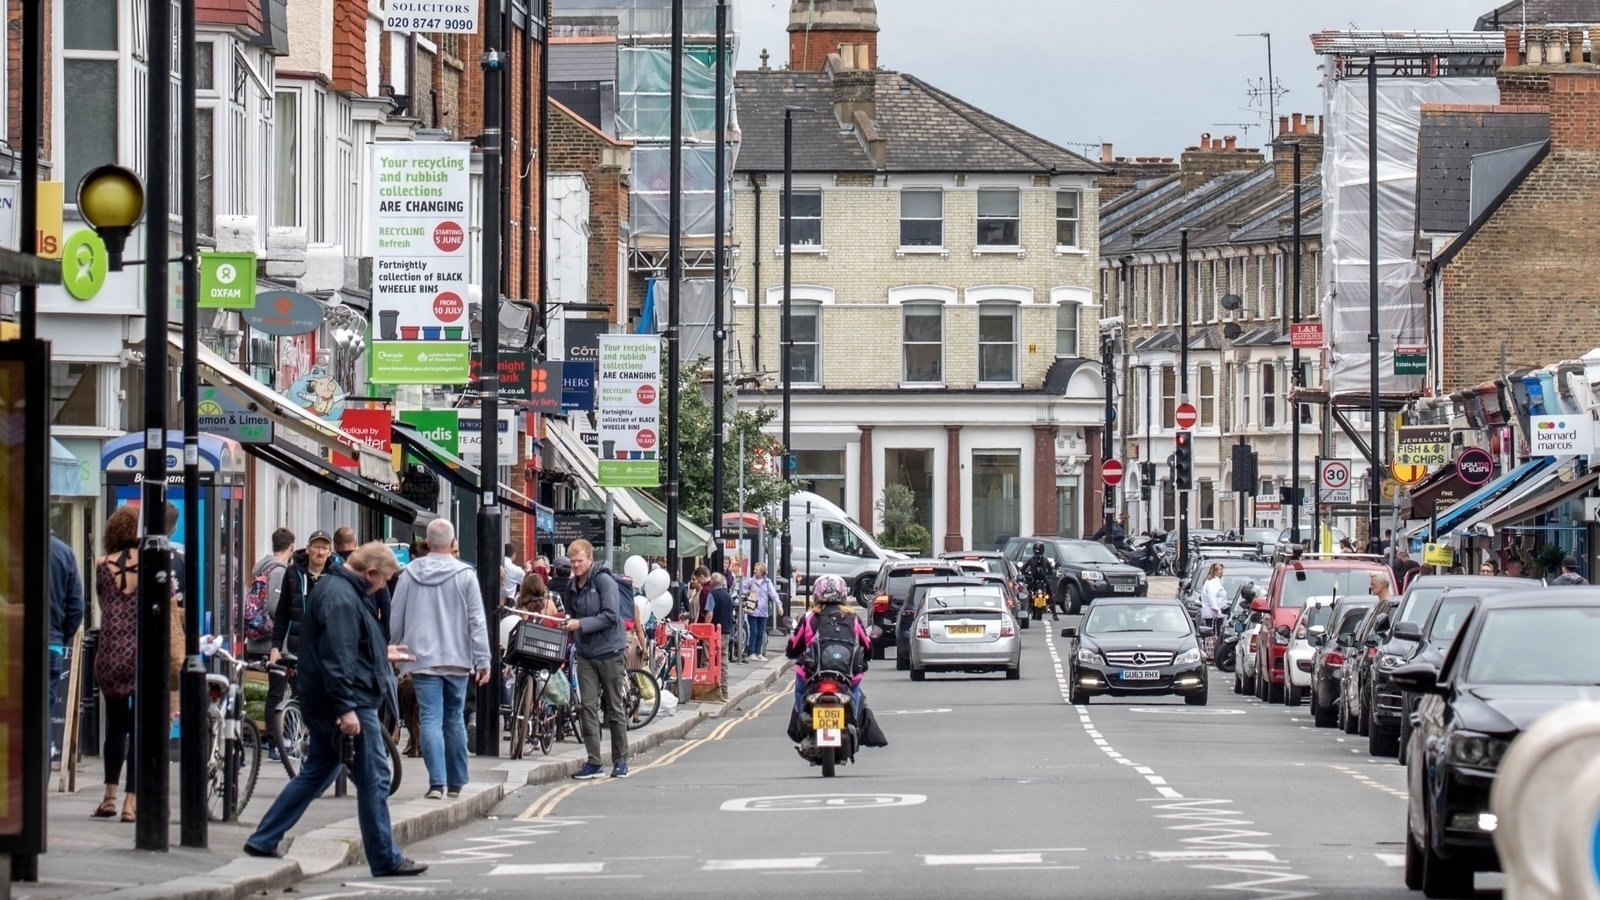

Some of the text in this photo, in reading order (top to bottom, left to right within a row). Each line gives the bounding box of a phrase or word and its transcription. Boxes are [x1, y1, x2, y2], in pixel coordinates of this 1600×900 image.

[392, 3, 470, 13] SOLICITORS
[387, 17, 473, 30] 020 8747 9090
[380, 156, 464, 171] Your recycling
[380, 171, 448, 182] and rubbish
[379, 185, 443, 197] collections
[379, 201, 464, 212] ARE CHANGING
[379, 227, 425, 236] RECYCLING
[379, 239, 411, 248] Refresh
[379, 260, 427, 271] Fortnightly
[379, 273, 463, 281] collection of BLACK
[211, 288, 241, 298] OXFAM
[379, 285, 439, 293] WHEELIE BINS
[434, 307, 463, 315] 10 JULY
[623, 343, 656, 354] recycling
[498, 361, 525, 373] night
[603, 362, 643, 370] collections
[499, 373, 519, 382] ank
[603, 371, 656, 379] ARE CHANGING
[562, 379, 589, 387] HERS
[198, 415, 269, 424] emon & Limes
[370, 427, 379, 435] by
[1537, 430, 1577, 440] barnard
[1397, 445, 1421, 453] FISH
[1537, 442, 1573, 450] marcus
[1413, 455, 1444, 463] CHIPS
[1327, 470, 1345, 480] 30
[823, 728, 835, 741] L
